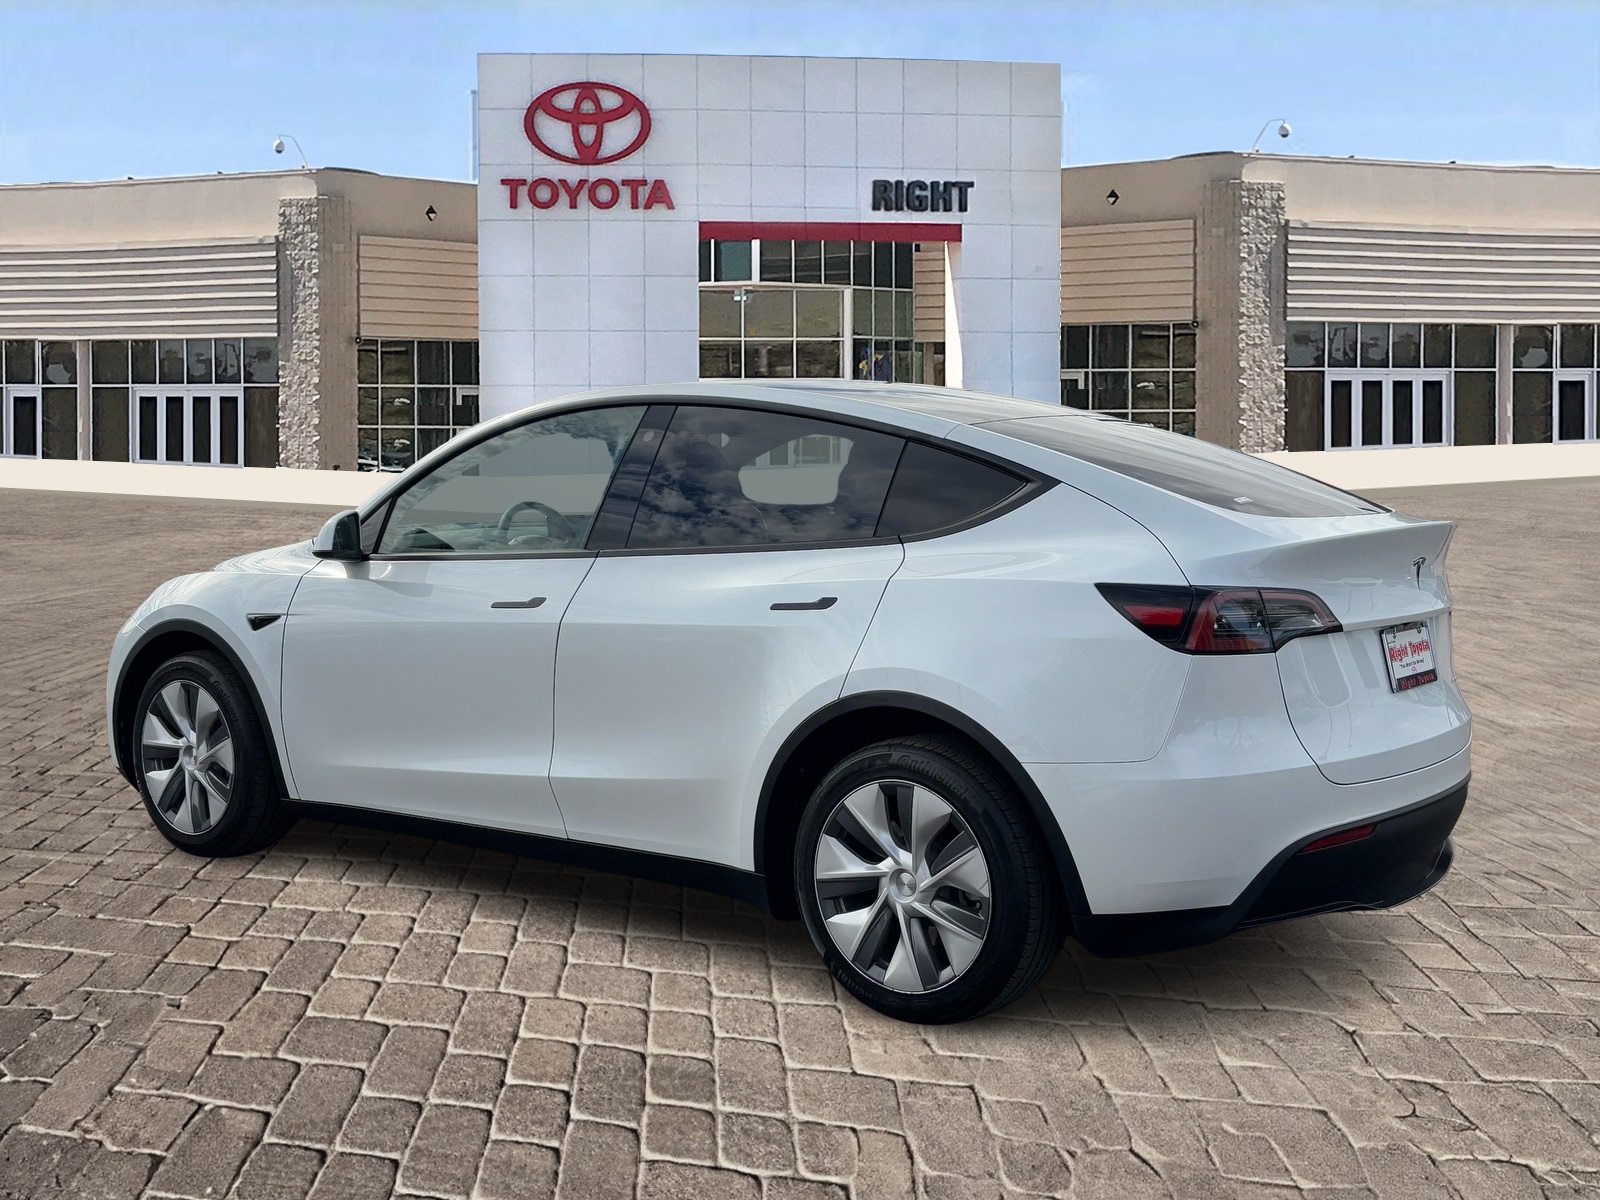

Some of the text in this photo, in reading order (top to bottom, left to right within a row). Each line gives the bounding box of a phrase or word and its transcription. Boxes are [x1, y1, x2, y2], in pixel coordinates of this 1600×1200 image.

[500, 179, 675, 210] TOYOTA
[871, 179, 975, 213] RIGHT
[1389, 639, 1430, 662] Right Toyota
[1401, 674, 1434, 689] Right Toyota
[898, 755, 971, 800] Continental
